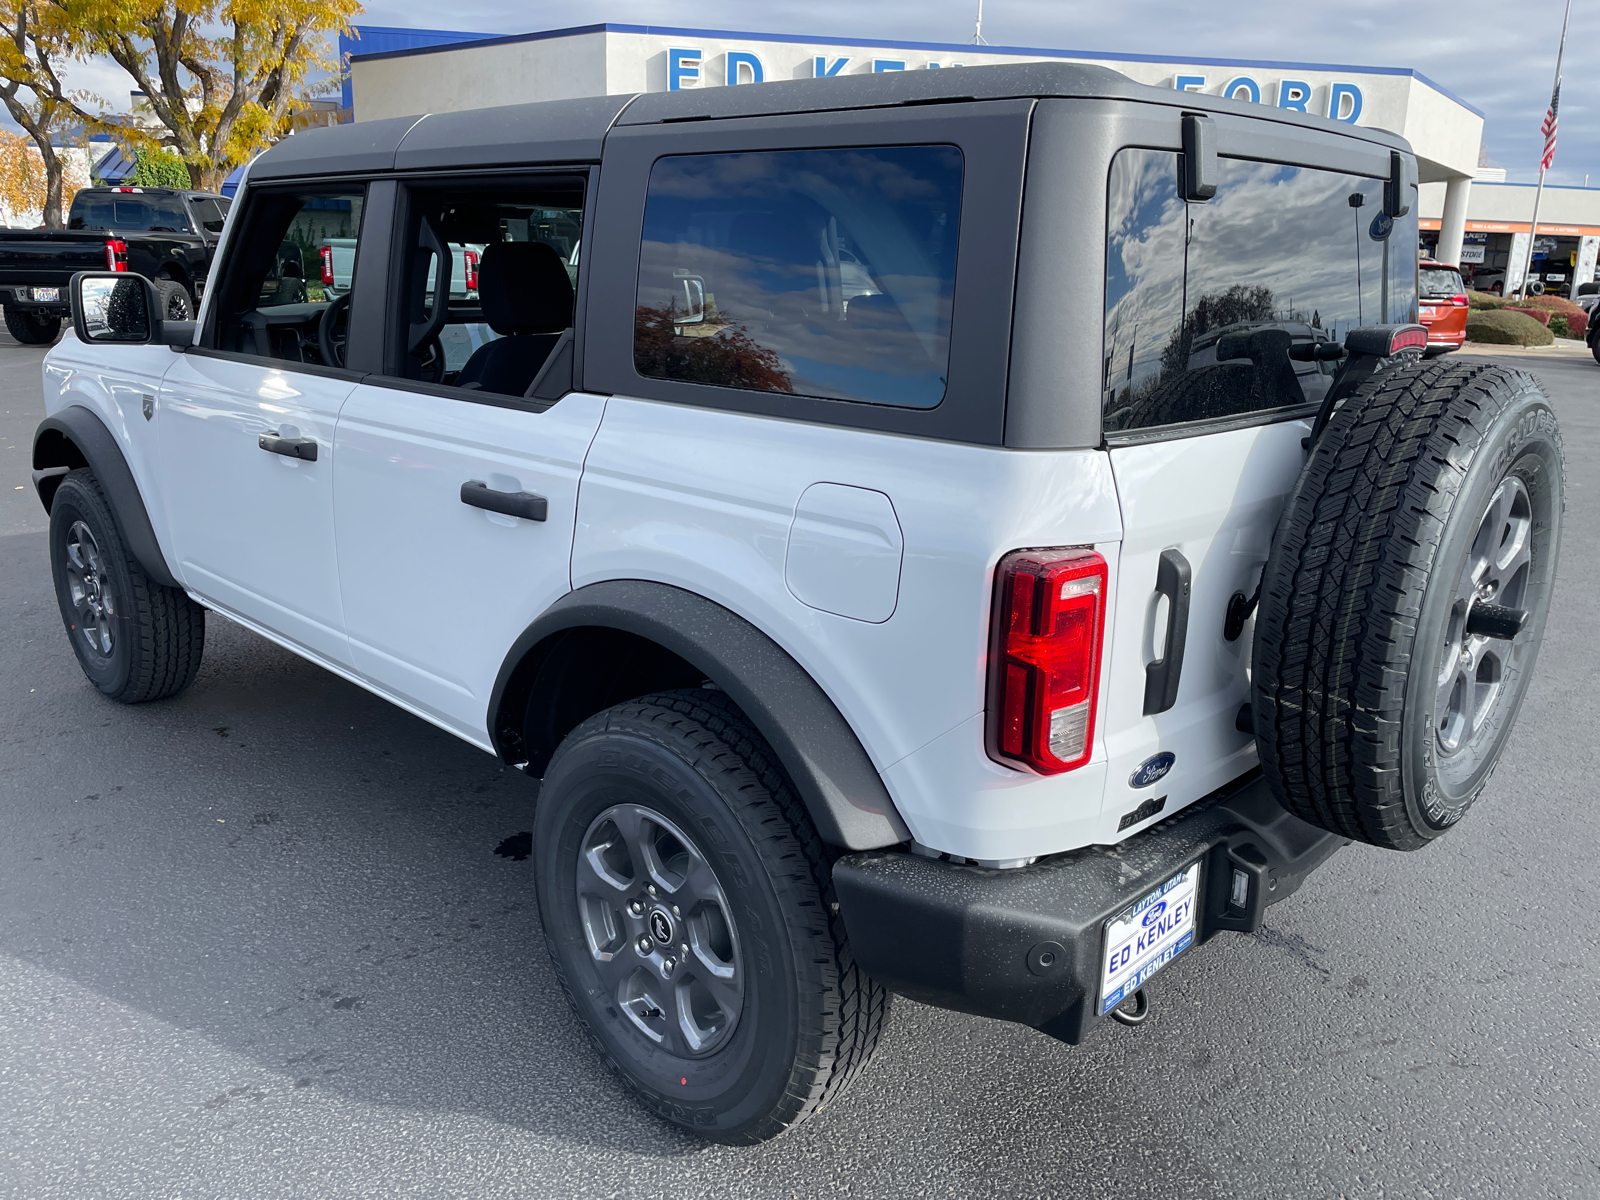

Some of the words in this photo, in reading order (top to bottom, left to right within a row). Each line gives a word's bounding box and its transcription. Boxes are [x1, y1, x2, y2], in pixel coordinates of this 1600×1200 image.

[666, 46, 766, 92] ED
[596, 745, 750, 890] DUELER
[1163, 872, 1183, 893] UTAH
[1109, 944, 1131, 974] ED
[1136, 897, 1192, 955] KENLEY
[1123, 978, 1138, 996] ED
[1139, 944, 1178, 982] KENLEY
